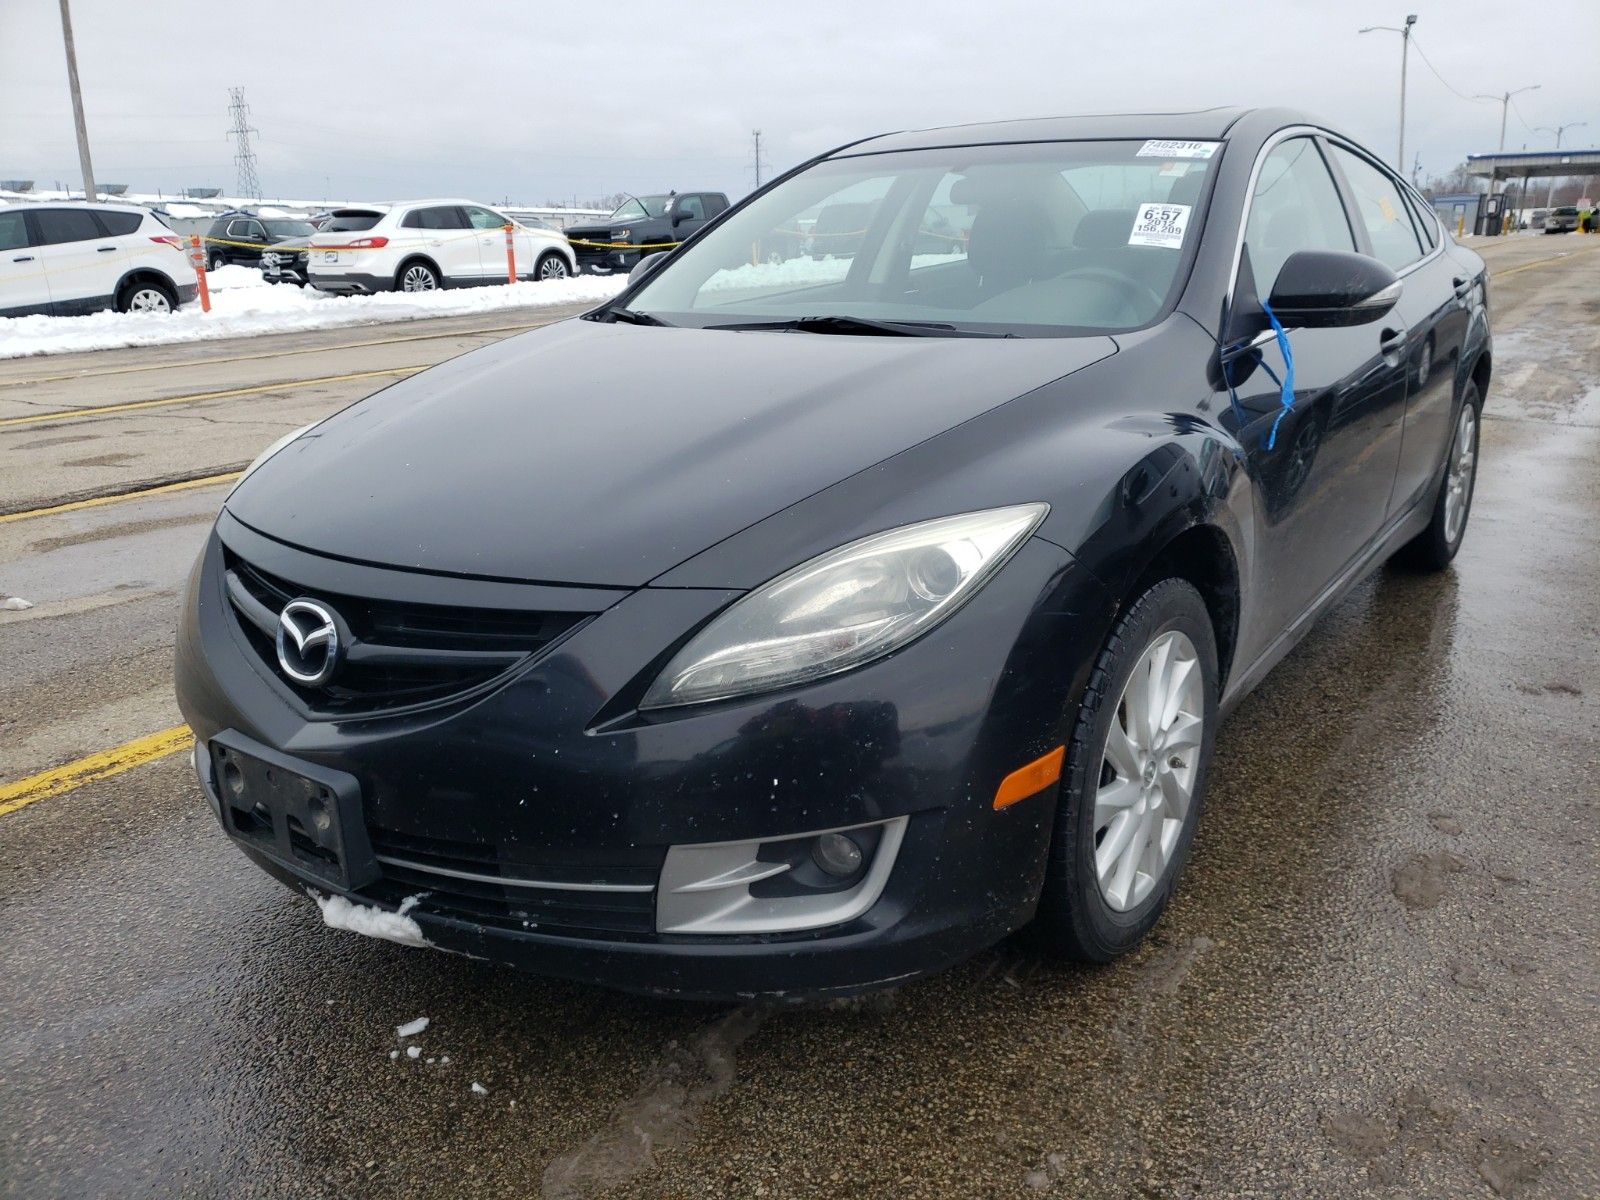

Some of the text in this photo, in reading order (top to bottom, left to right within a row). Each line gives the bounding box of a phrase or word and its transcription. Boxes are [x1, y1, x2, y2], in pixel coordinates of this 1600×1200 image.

[1144, 209, 1181, 221] 6:57
[1147, 219, 1175, 227] 2012
[1138, 224, 1182, 235] 156,209
